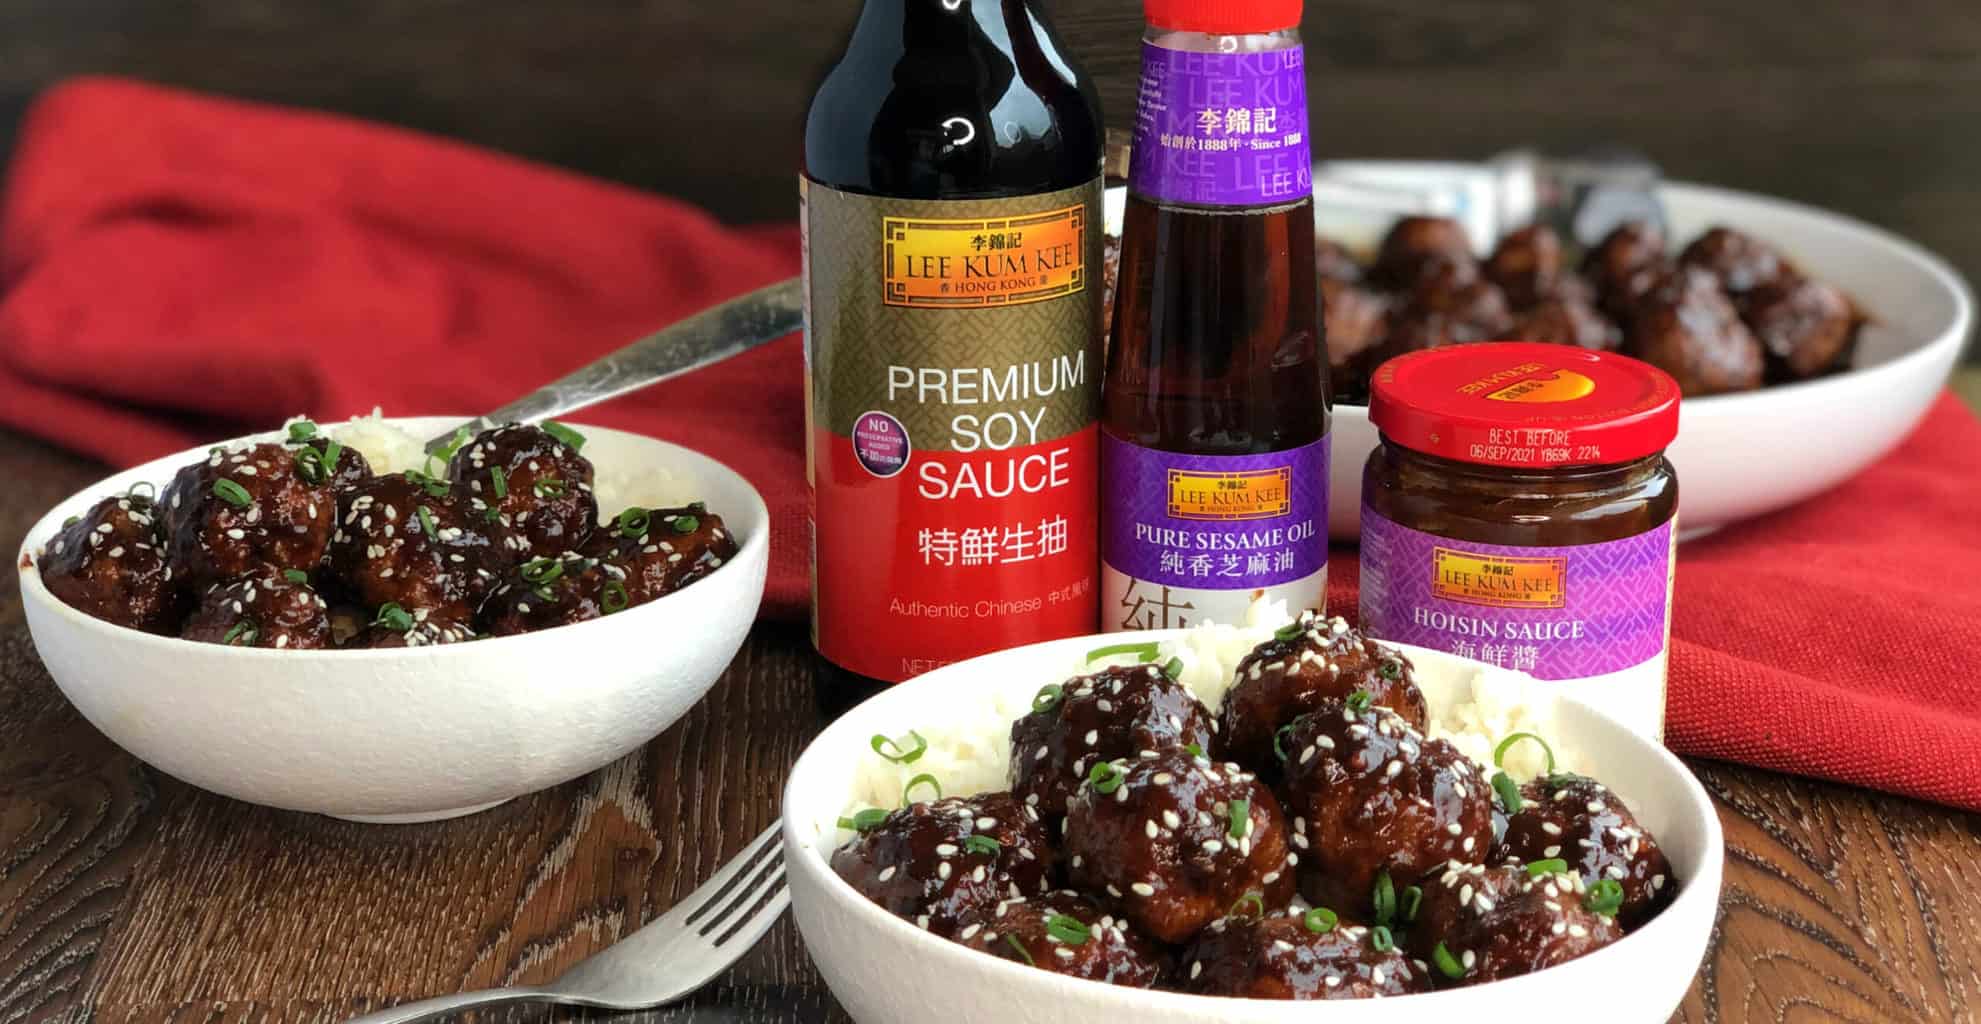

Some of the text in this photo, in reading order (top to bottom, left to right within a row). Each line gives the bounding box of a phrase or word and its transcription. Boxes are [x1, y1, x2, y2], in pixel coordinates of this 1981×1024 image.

[1196, 107, 1277, 135] 李錦記
[1250, 138, 1281, 150] Since
[1261, 173, 1294, 197] LEE
[971, 232, 1022, 251] 李錦記
[905, 243, 1073, 279] LEE KUM KEE
[955, 278, 1036, 294] HONG KONG
[888, 349, 1084, 404] PREMIUM
[869, 418, 889, 433] NO
[950, 406, 1047, 453] SOY
[1489, 427, 1571, 446] BEST BEFORE
[1470, 443, 1535, 462] 06/SEP/2021
[918, 447, 1070, 500] SAUCE
[1181, 488, 1281, 505] LEE KUM KEE
[918, 513, 1068, 567] 特鮮生抽
[1135, 519, 1316, 551] PURE SESAME OIL
[1159, 547, 1295, 577] 純香芝麻油
[1446, 569, 1553, 591] LEE KUM KEE
[889, 598, 969, 618] Authentic
[975, 597, 1042, 618] Chinese
[1414, 607, 1584, 641] HOISIN SAUCE
